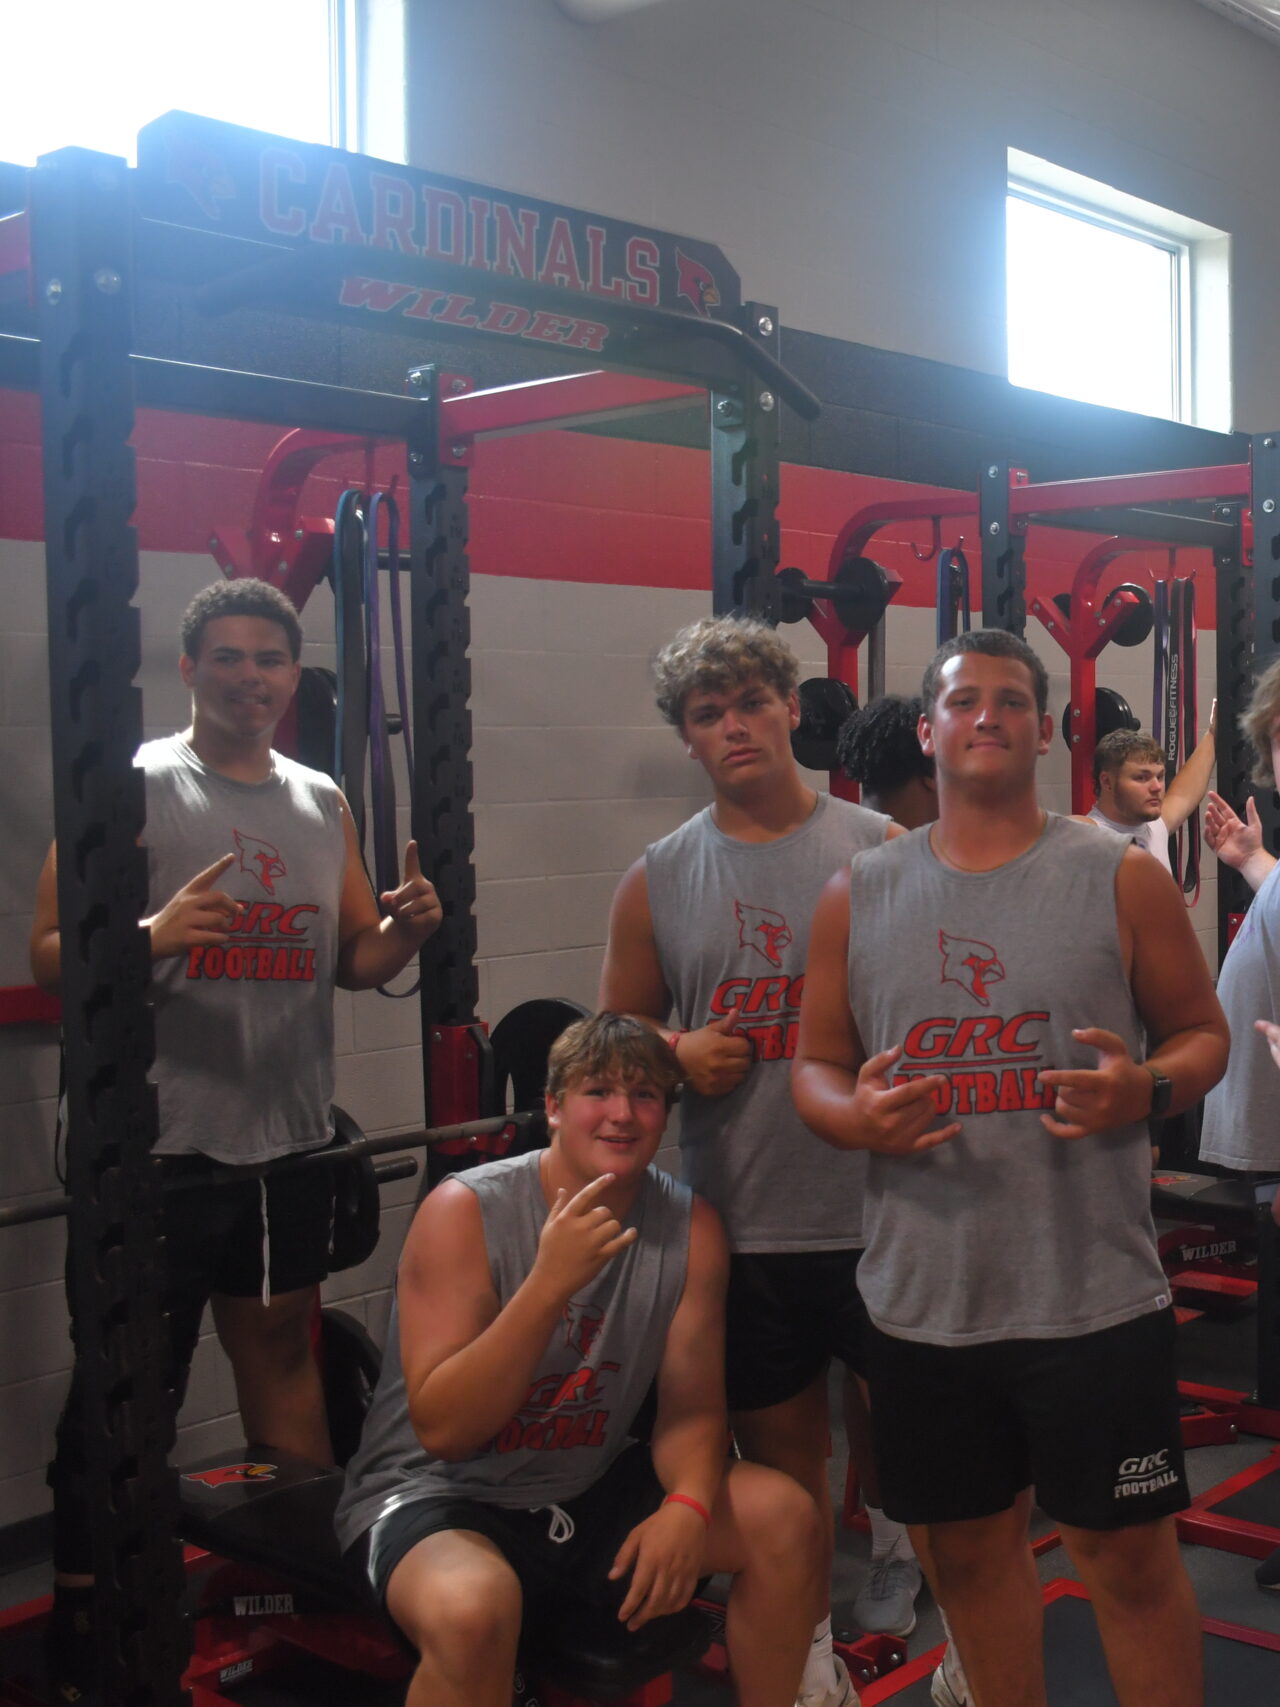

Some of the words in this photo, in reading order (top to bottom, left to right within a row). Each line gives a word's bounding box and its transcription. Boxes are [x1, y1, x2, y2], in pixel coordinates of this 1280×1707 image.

[259, 146, 661, 306] CARDINALS
[338, 275, 610, 352] WILDER
[1169, 653, 1178, 708] FITNESS
[1167, 717, 1177, 761] ROGUE
[904, 1010, 1051, 1059] GRC
[1182, 1240, 1237, 1262] WILDER
[1118, 1448, 1169, 1475] GRC
[1114, 1469, 1179, 1499] FOOTBALL
[233, 1593, 295, 1617] WILDER
